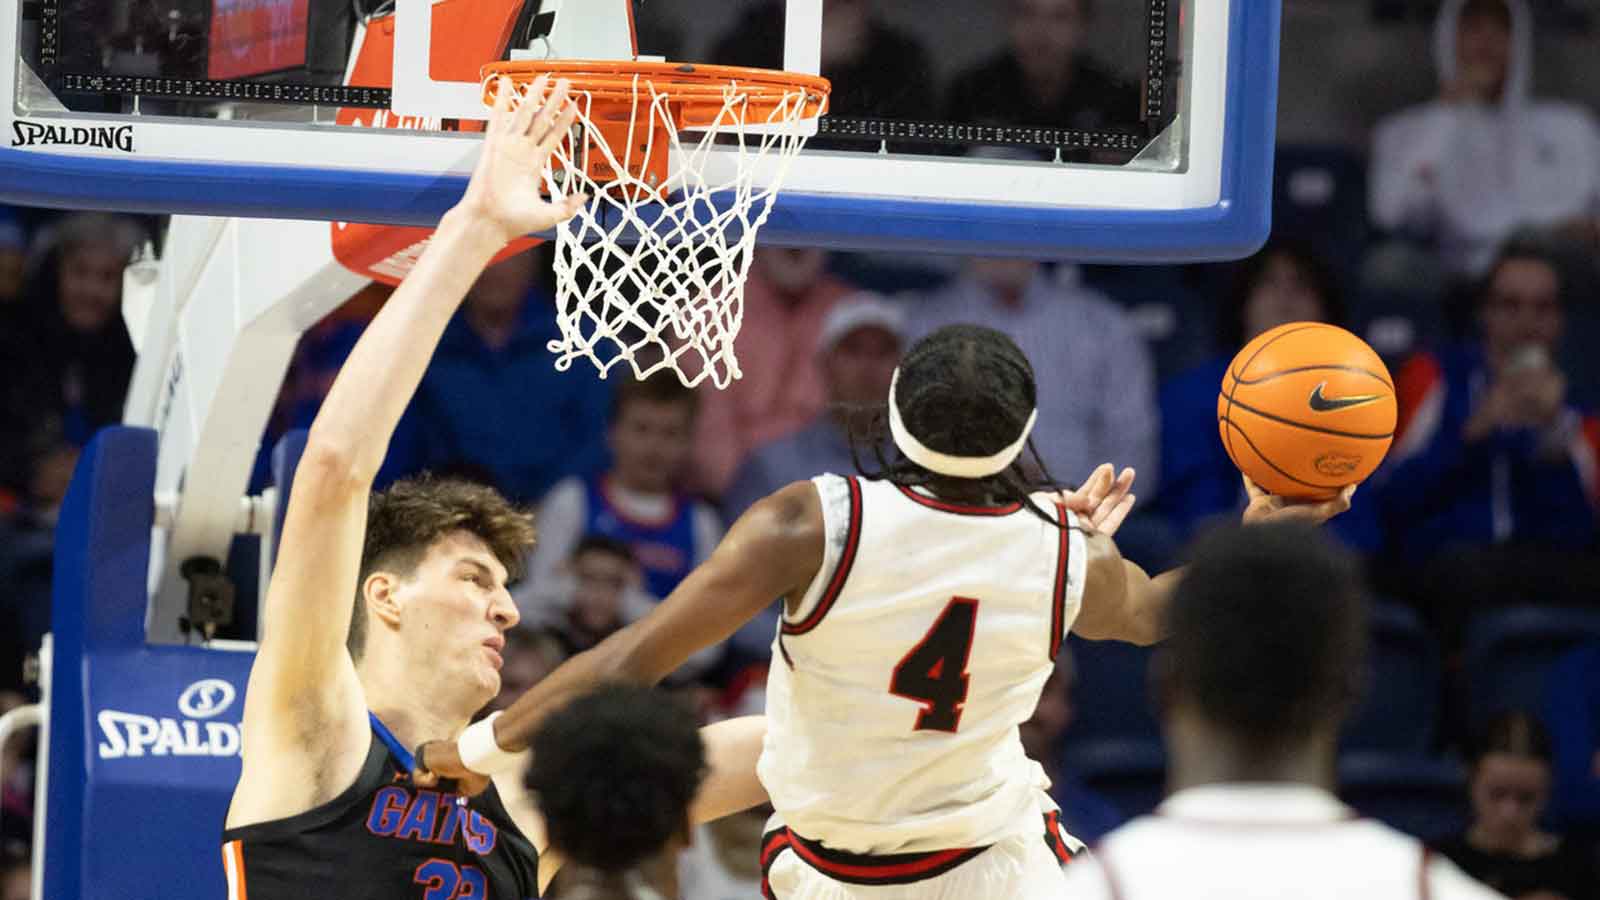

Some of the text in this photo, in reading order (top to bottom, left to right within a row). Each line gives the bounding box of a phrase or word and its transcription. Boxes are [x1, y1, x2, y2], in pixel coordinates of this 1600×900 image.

[11, 120, 133, 152] SPALDING
[888, 596, 979, 733] 4
[98, 709, 243, 759] SPALD
